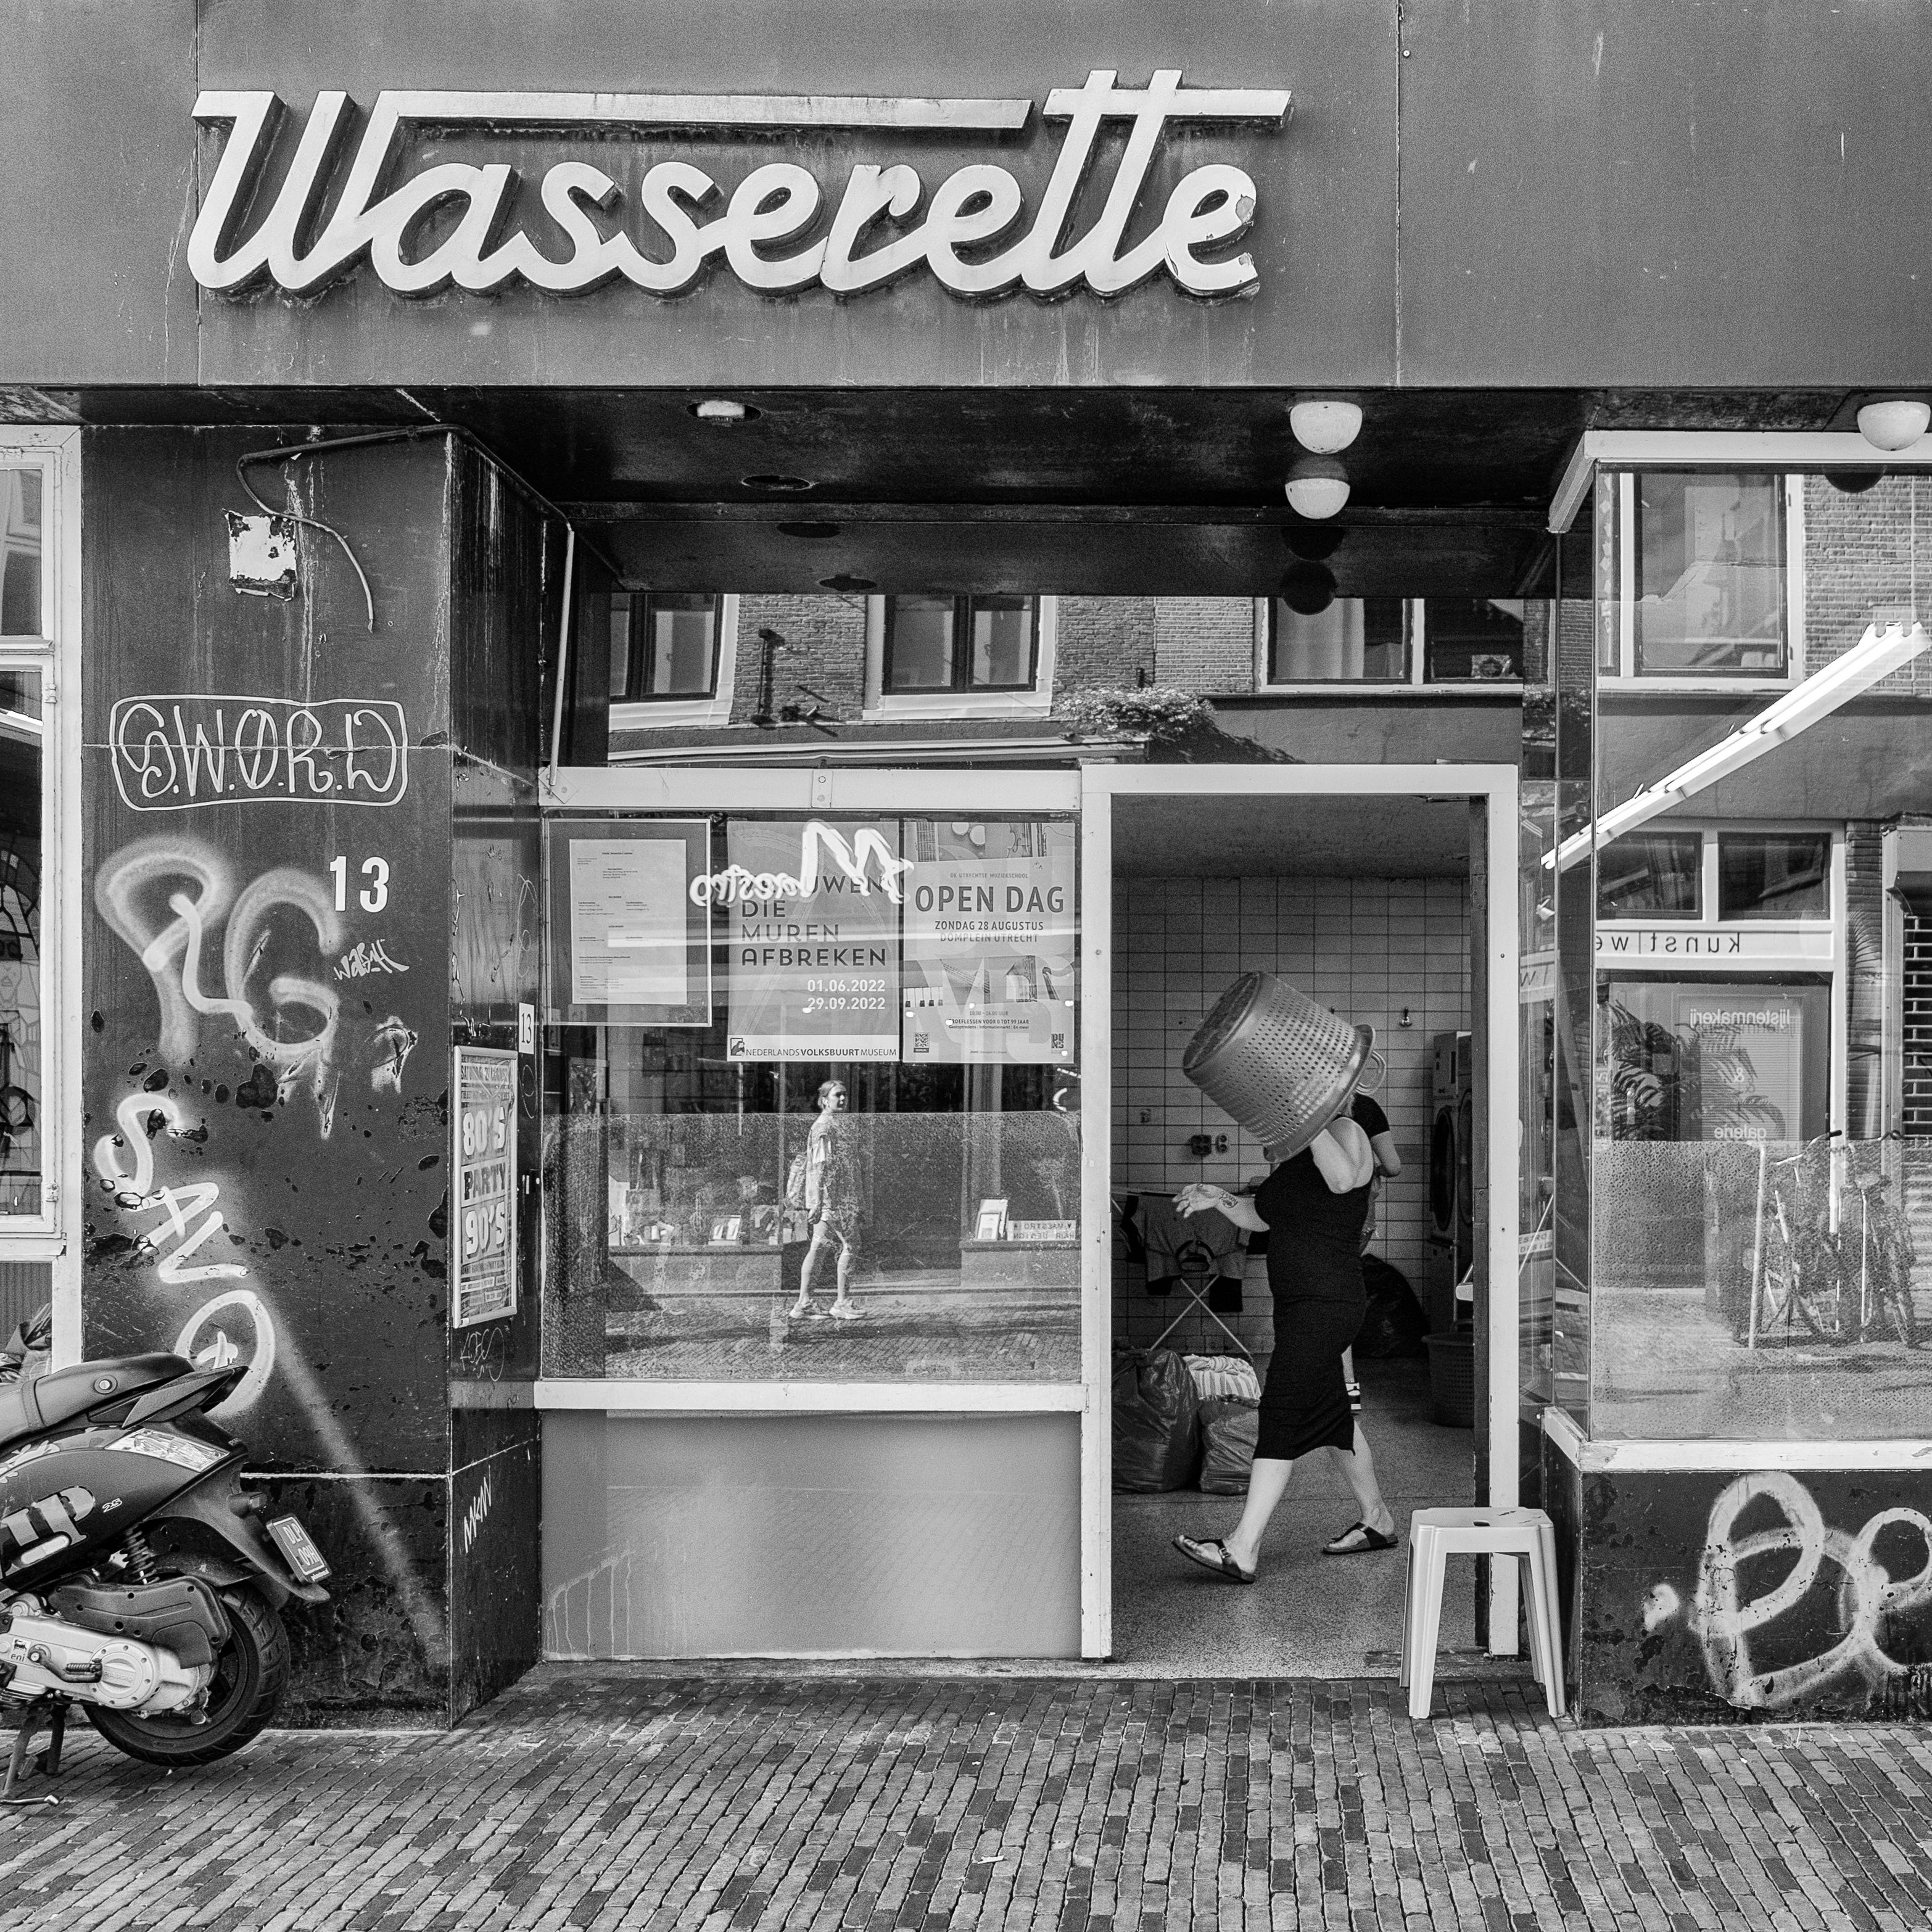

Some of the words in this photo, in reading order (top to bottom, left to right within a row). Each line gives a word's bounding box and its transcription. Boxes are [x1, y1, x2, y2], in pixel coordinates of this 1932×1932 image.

[187, 70, 1292, 294] Wasserette
[329, 856, 390, 913] 13
[741, 899, 786, 918] DIE
[915, 885, 994, 912] OPEN
[1006, 886, 1064, 913] DAG
[741, 924, 839, 943] MUREN
[935, 920, 975, 930] ZONDAG
[978, 921, 989, 930] 28
[991, 921, 1044, 931] AUGUSTUS
[939, 933, 991, 942] DOMPLEIN
[994, 933, 1039, 943] UTRECHT
[741, 948, 886, 966] AFBREKEN
[807, 979, 886, 992] 01.06.2022
[807, 997, 886, 1010] 29.09.2022
[521, 1012, 532, 1044] 13
[463, 1162, 505, 1201] PARTY
[465, 1200, 505, 1257] 90'S
[283, 1522, 303, 1544] DLP
[10, 1653, 25, 1662] eni
